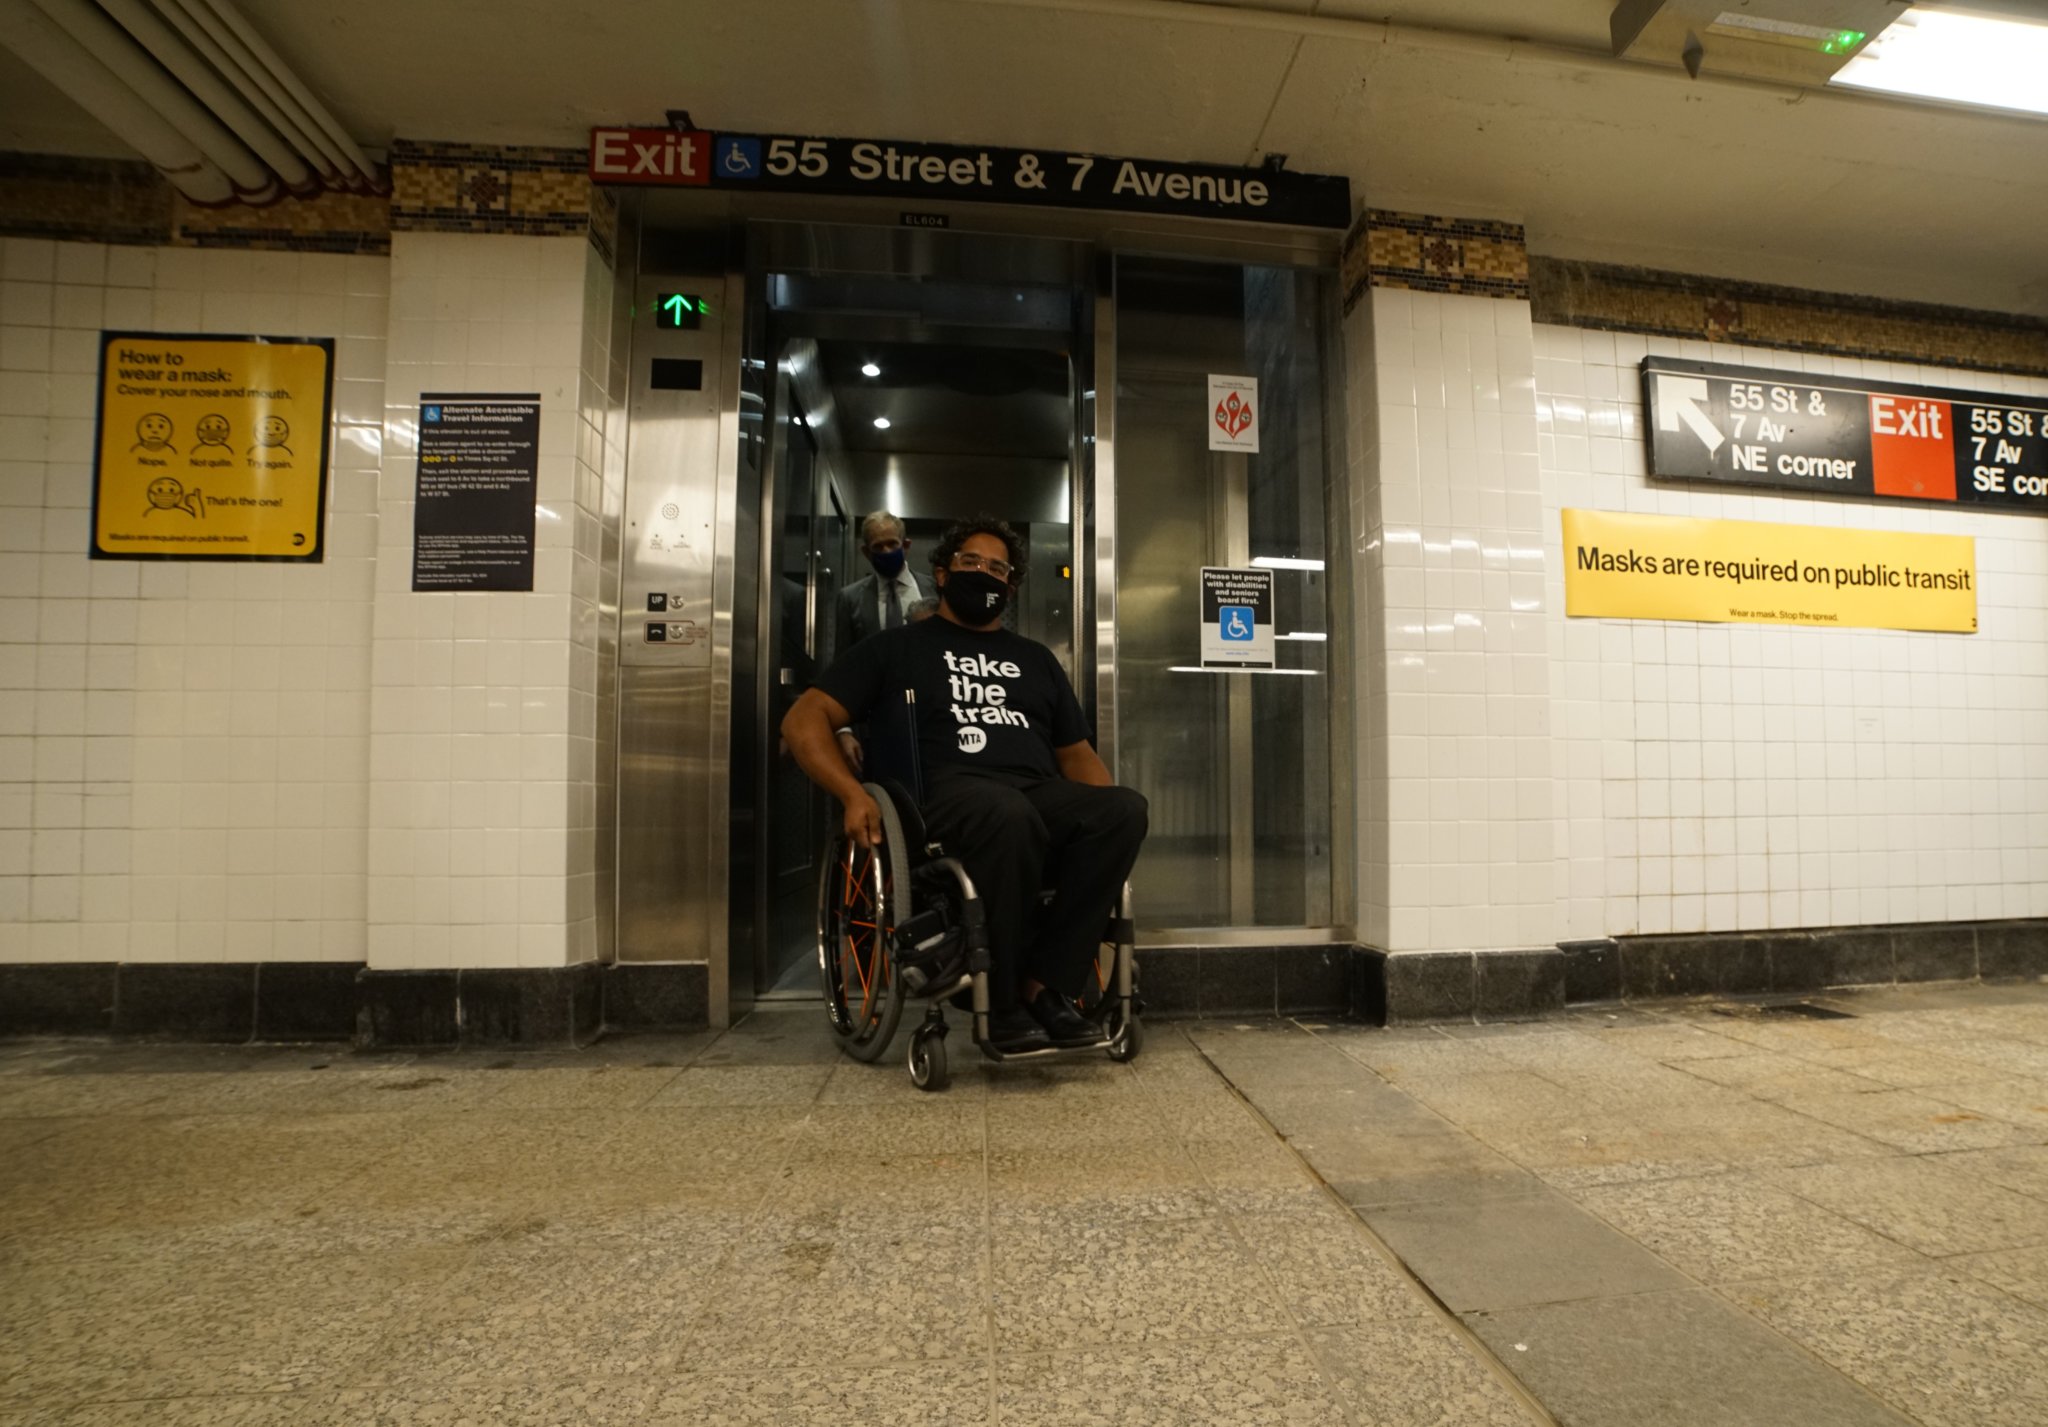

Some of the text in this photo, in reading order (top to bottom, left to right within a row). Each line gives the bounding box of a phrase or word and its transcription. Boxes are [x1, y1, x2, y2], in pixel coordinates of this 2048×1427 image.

[593, 131, 696, 177] Exit
[766, 139, 1270, 206] 55 Street & 7 Avenue
[905, 214, 943, 226] EL604
[119, 349, 184, 366] How to
[118, 368, 232, 382] wear a mask:
[116, 384, 292, 400] Cover your nose and mouth.
[1729, 383, 1827, 417] 55 St &
[442, 406, 534, 414] Alternate Accessible
[1870, 396, 1943, 440] Exit
[1730, 414, 1786, 443] 7 Av
[1970, 407, 2003, 434] 55
[2007, 410, 2034, 437] St
[1971, 436, 2022, 465] 7 Av
[138, 457, 168, 467] Nope.
[189, 457, 207, 467] Not
[1732, 445, 1857, 480] NE corner
[1973, 465, 2006, 492] SE
[206, 495, 283, 508] That's the one!
[1577, 545, 1972, 591] Masks are required on public transit
[1204, 572, 1231, 580] Please
[1244, 574, 1270, 582] people
[1207, 580, 1267, 589] with disabilities
[651, 596, 664, 604] UP
[1231, 589, 1259, 597] seniors
[1241, 597, 1260, 605] first.
[1729, 608, 1749, 617] Wear
[1756, 610, 1779, 618] mask.
[1779, 610, 1798, 620] Stop
[1799, 612, 1811, 620] the
[1812, 613, 1839, 622] spread.
[943, 651, 1022, 678] take
[948, 674, 1007, 706] the
[950, 703, 1030, 729] train
[958, 733, 982, 746] MTA
